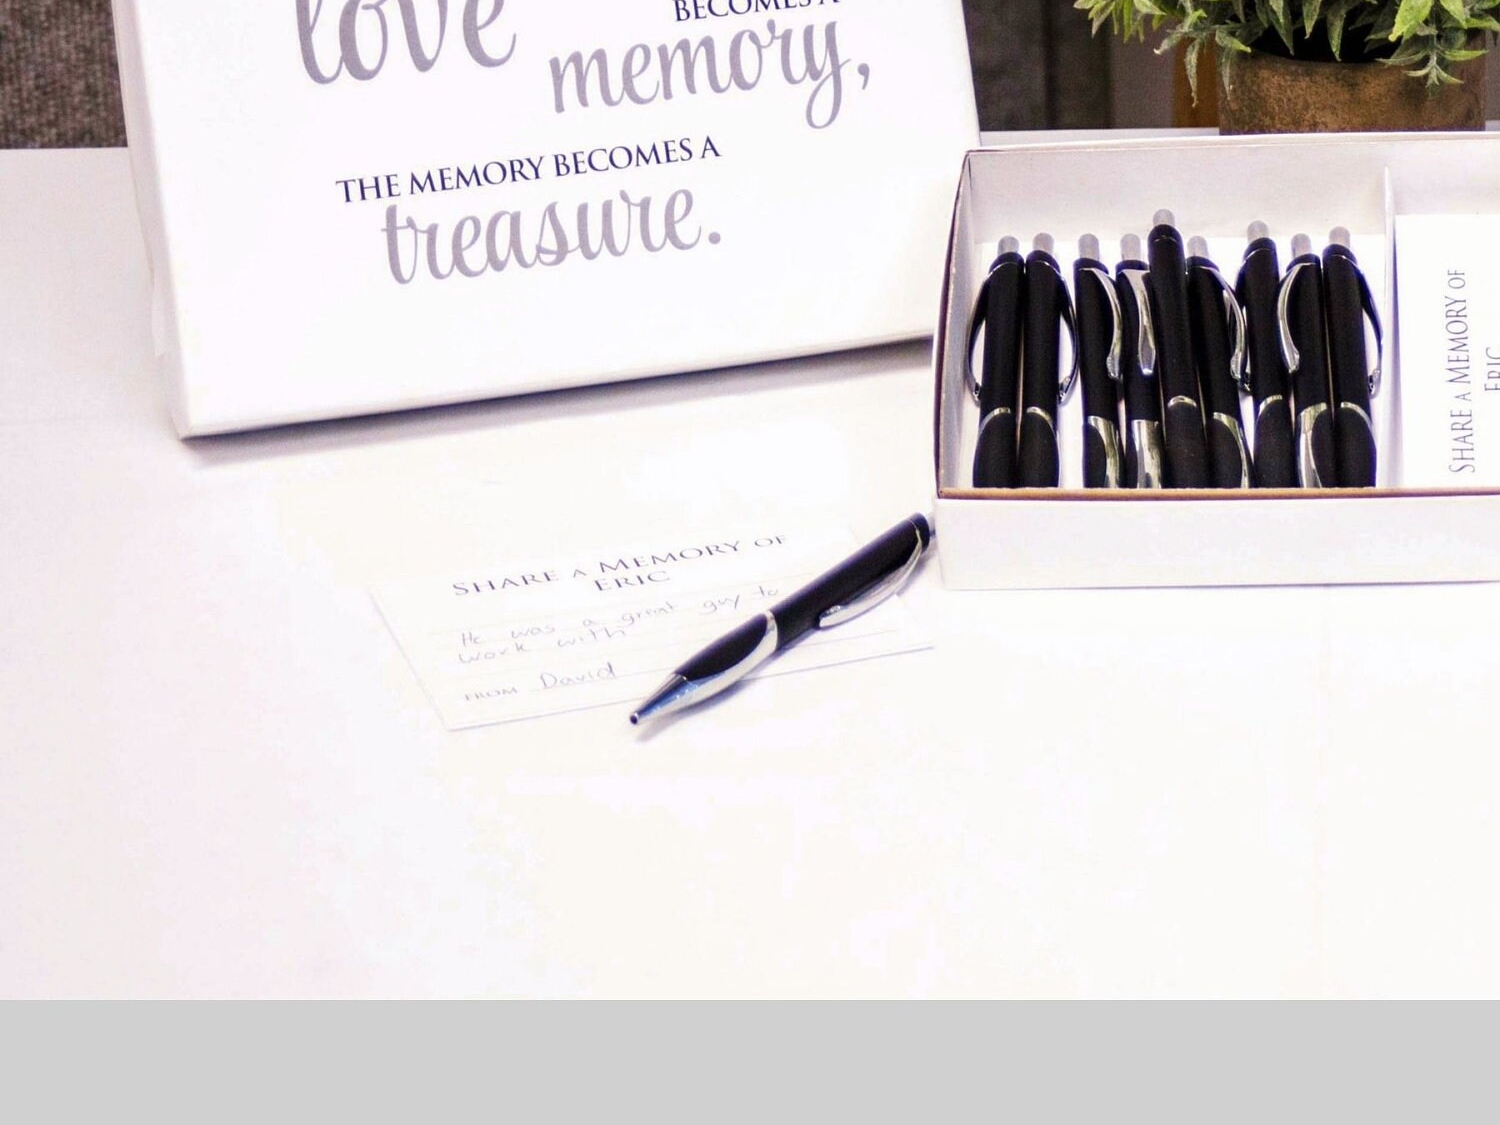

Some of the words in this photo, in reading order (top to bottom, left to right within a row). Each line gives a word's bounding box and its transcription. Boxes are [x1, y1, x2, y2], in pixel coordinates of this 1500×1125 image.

[548, 19, 871, 129] memory,
[335, 174, 402, 204] THE
[408, 155, 545, 196] MEMORY
[553, 138, 693, 178] BECOMES
[694, 135, 722, 159] A
[380, 188, 722, 285] treasure.
[1447, 269, 1466, 289] OF
[1444, 295, 1471, 385] MEMORY
[1458, 392, 1472, 402] A
[1448, 408, 1476, 474] SHARE
[452, 570, 559, 596] SHARE
[573, 569, 588, 579] A
[599, 539, 742, 574] MEMORY
[754, 535, 788, 548] OF
[595, 571, 671, 591] ERIC
